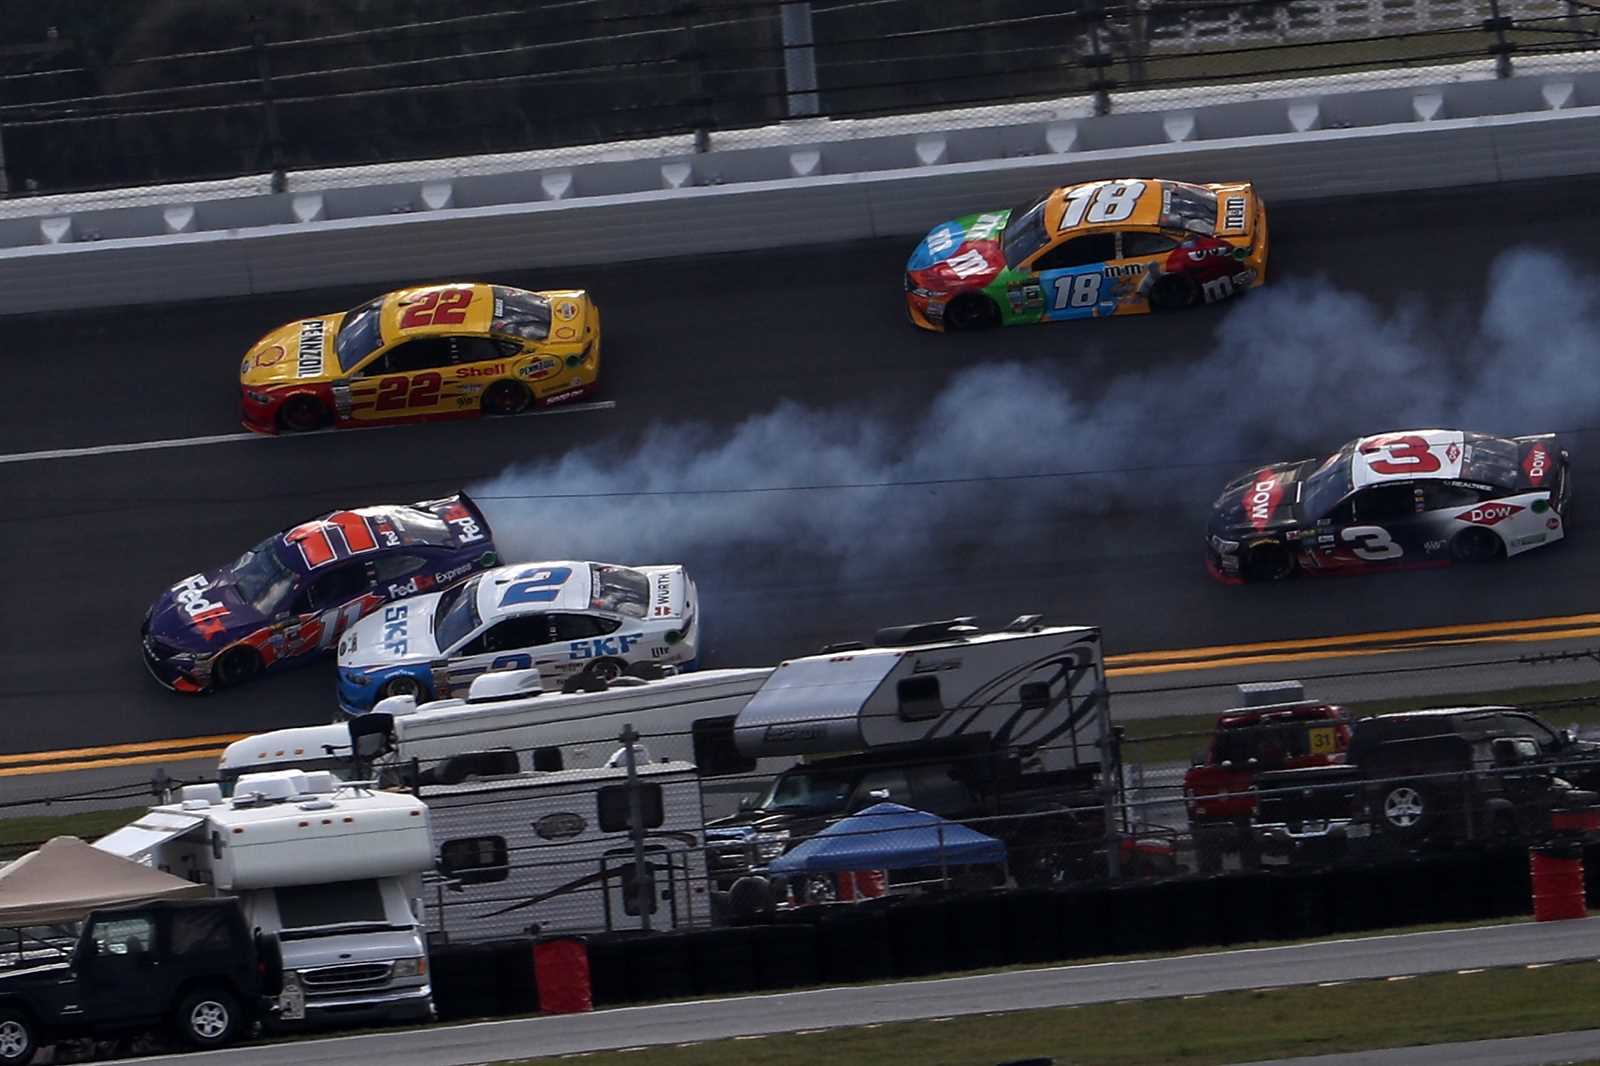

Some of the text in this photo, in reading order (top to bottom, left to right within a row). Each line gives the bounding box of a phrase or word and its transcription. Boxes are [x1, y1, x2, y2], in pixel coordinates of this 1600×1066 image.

[1058, 180, 1147, 230] 18
[400, 289, 473, 329] 22
[1053, 273, 1103, 309] 18
[298, 319, 325, 378] PENNZOIL
[375, 371, 442, 412] 22
[455, 364, 506, 379] Shell
[1359, 434, 1442, 475] 3
[283, 510, 380, 571] 11
[1341, 525, 1404, 561] 3
[435, 563, 473, 583] Express
[502, 565, 575, 608] 2
[384, 605, 408, 656] SKF
[569, 633, 643, 659] SKF
[1312, 734, 1331, 748] 31
